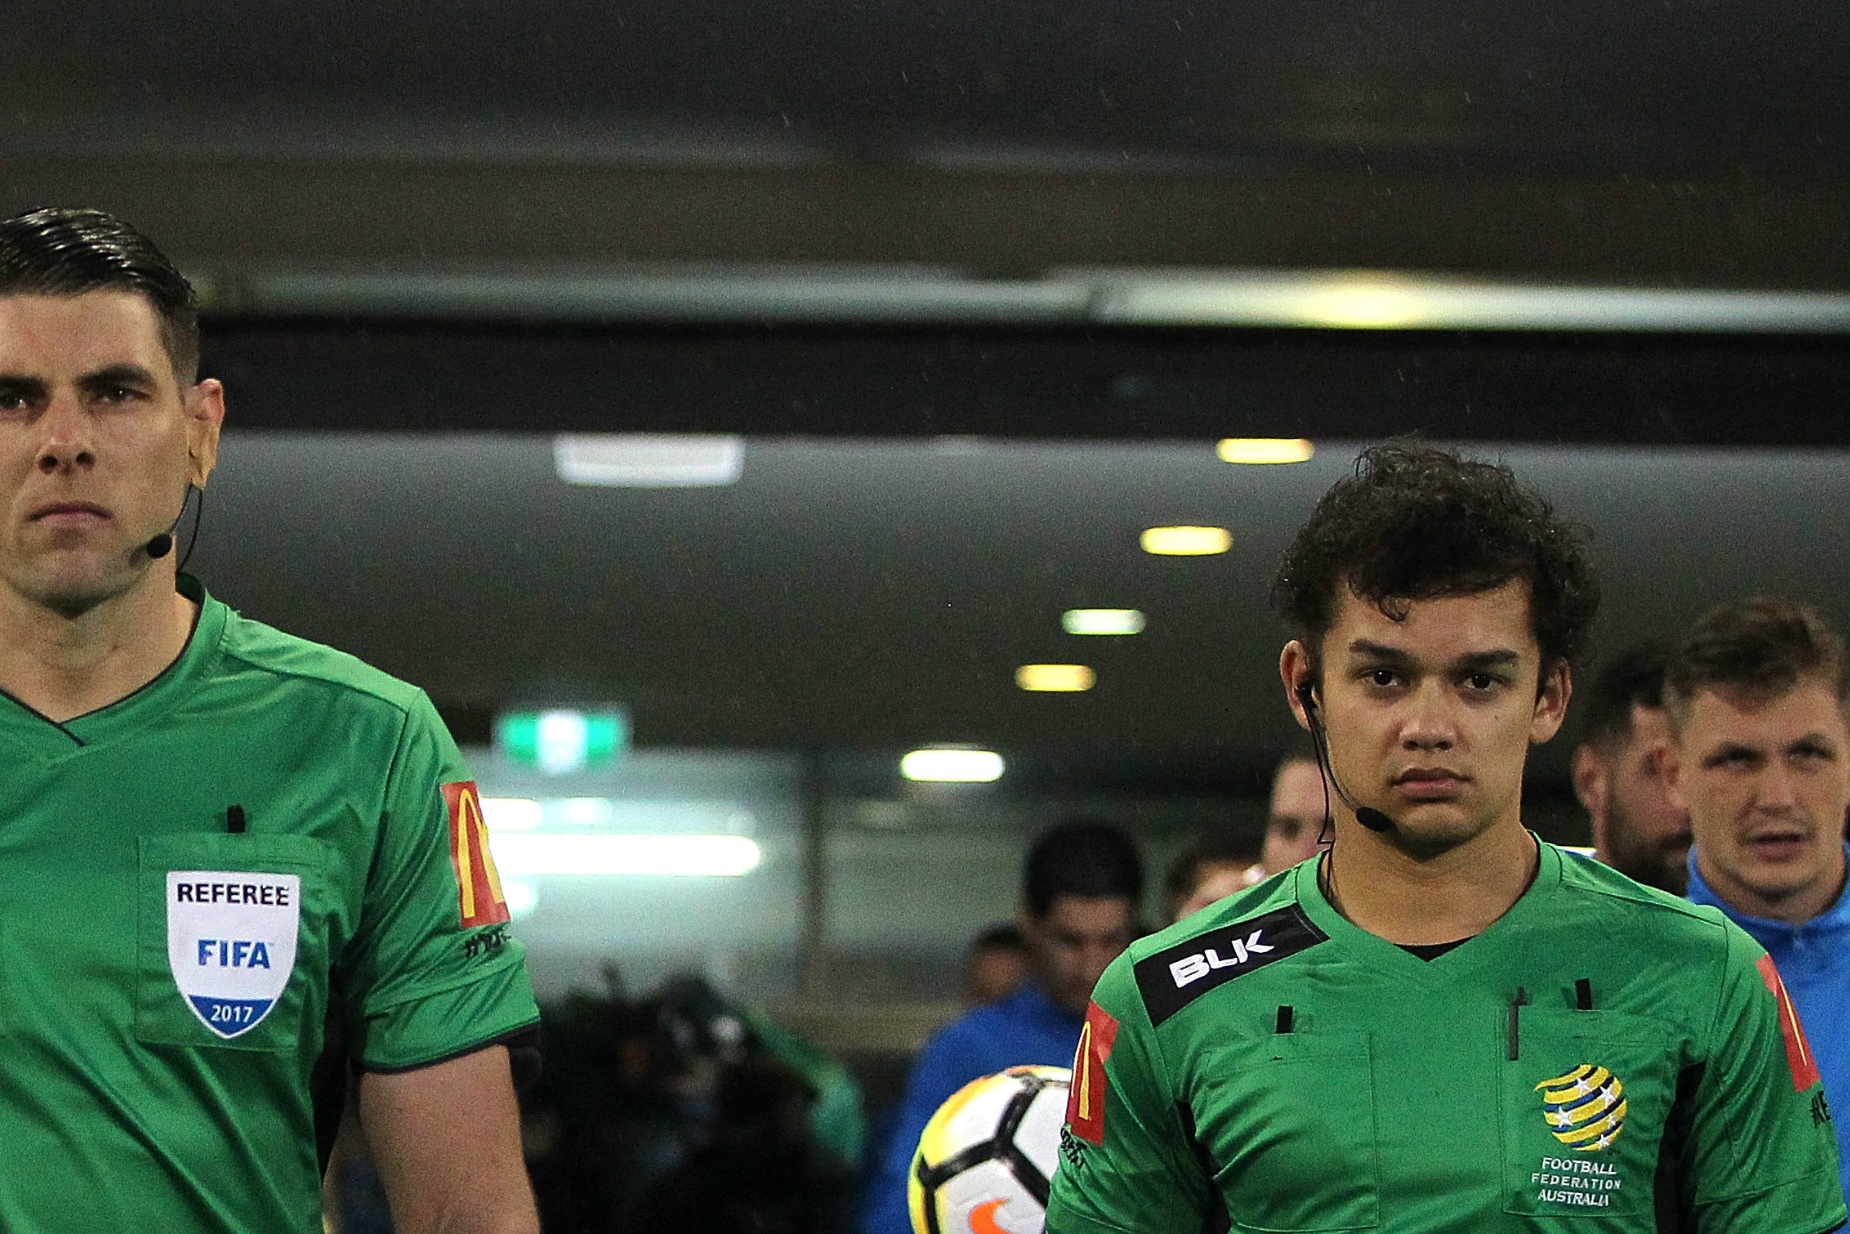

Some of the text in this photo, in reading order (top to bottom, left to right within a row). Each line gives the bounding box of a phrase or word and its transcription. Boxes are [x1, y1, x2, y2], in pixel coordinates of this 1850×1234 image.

[177, 883, 289, 906] REFEREE
[1168, 929, 1275, 989] BLK
[210, 1004, 253, 1022] 2017
[1541, 1157, 1618, 1175] FOOTBALL
[1531, 1173, 1622, 1191] FEDERATION
[1537, 1188, 1610, 1207] AUSTRALIA
